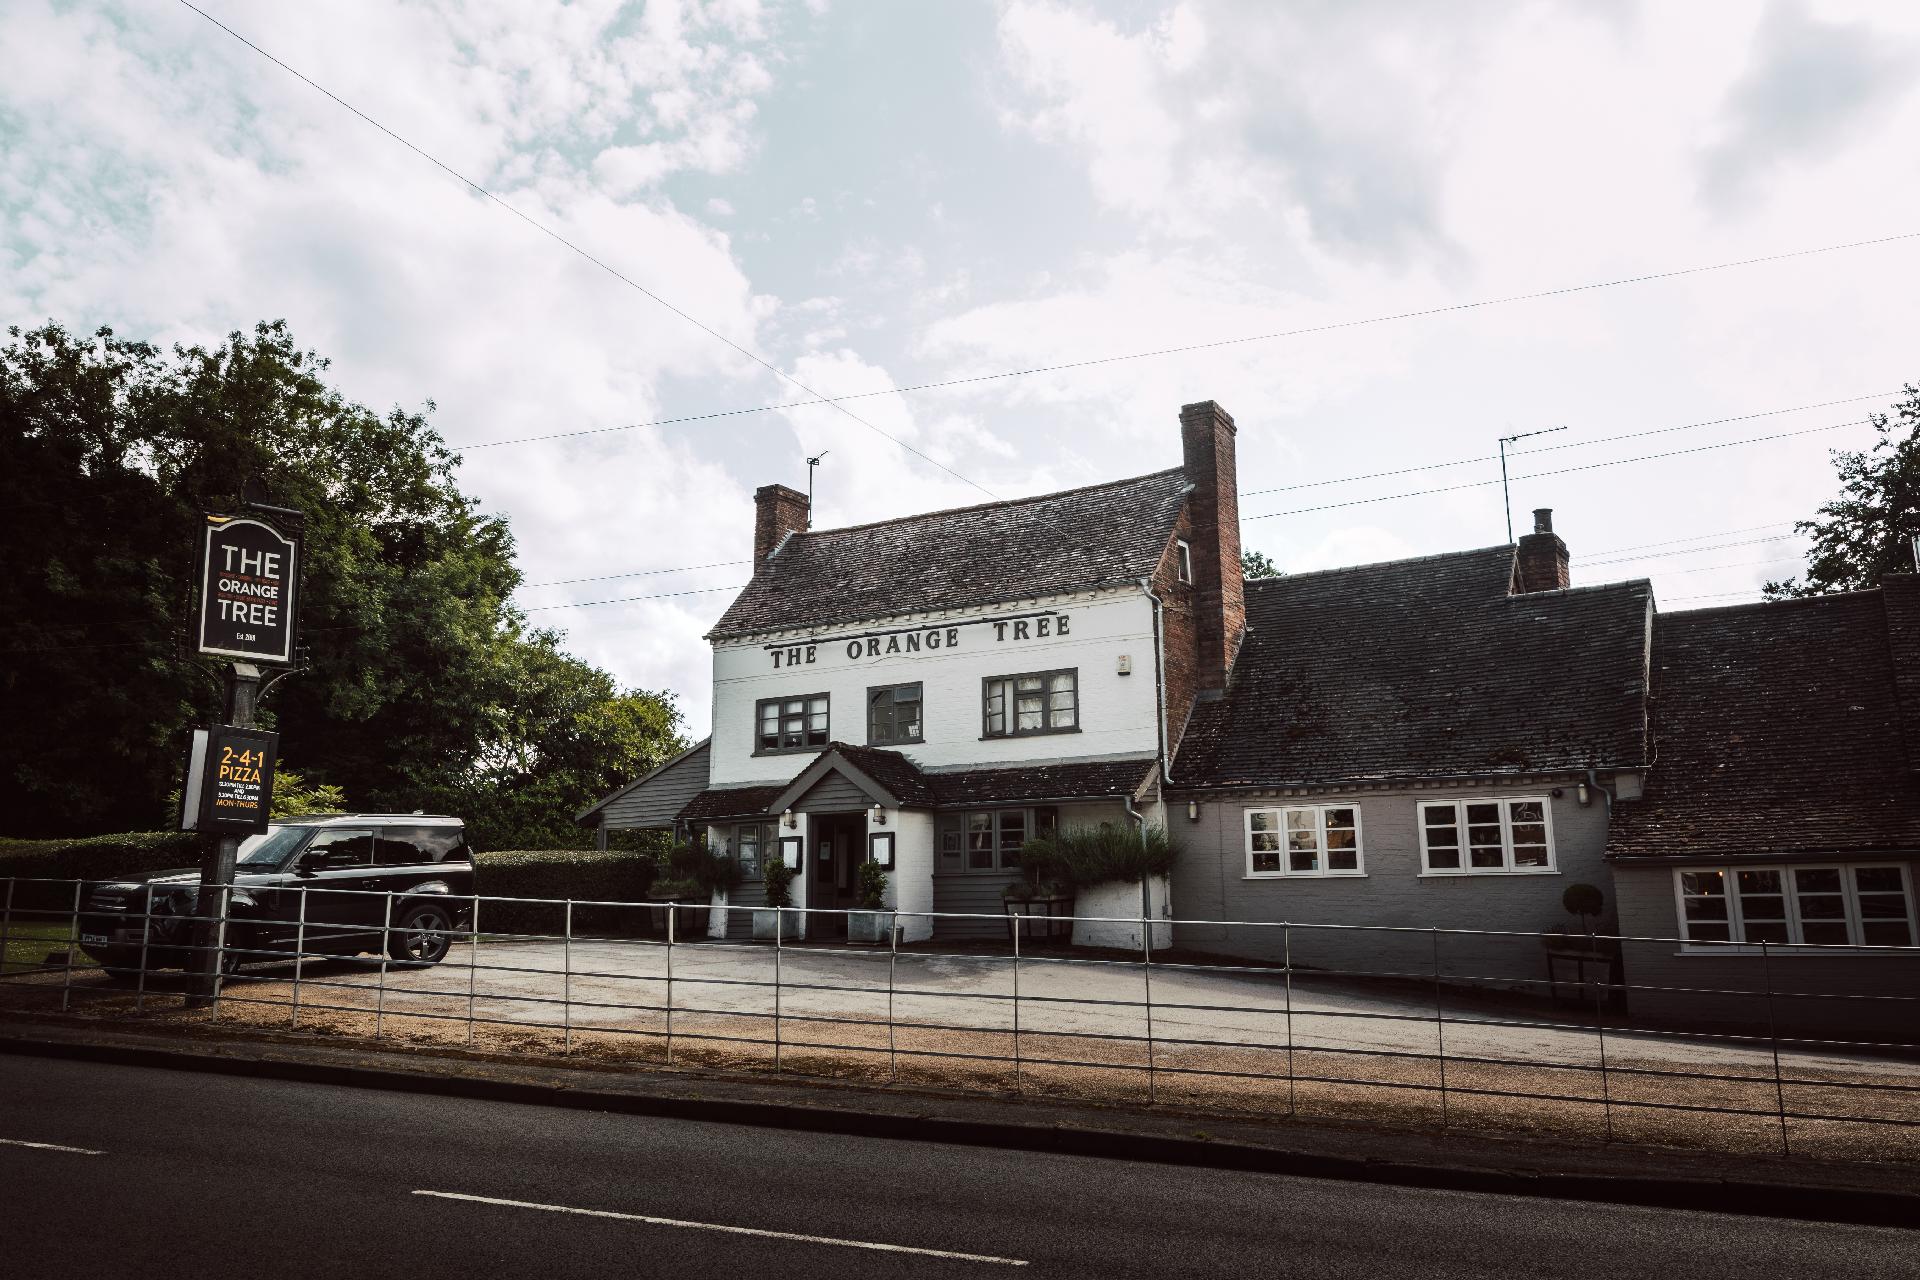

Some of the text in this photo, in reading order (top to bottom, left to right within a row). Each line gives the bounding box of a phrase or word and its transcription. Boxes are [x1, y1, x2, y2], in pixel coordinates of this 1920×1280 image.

[221, 544, 281, 580] THE
[218, 578, 279, 599] ORANGE
[217, 599, 278, 627] TREE
[770, 614, 1070, 669] THE ORANGE TREE
[221, 746, 264, 768] 2-4-1
[219, 765, 261, 784] PIZZA
[215, 799, 259, 809] MON-THURS
